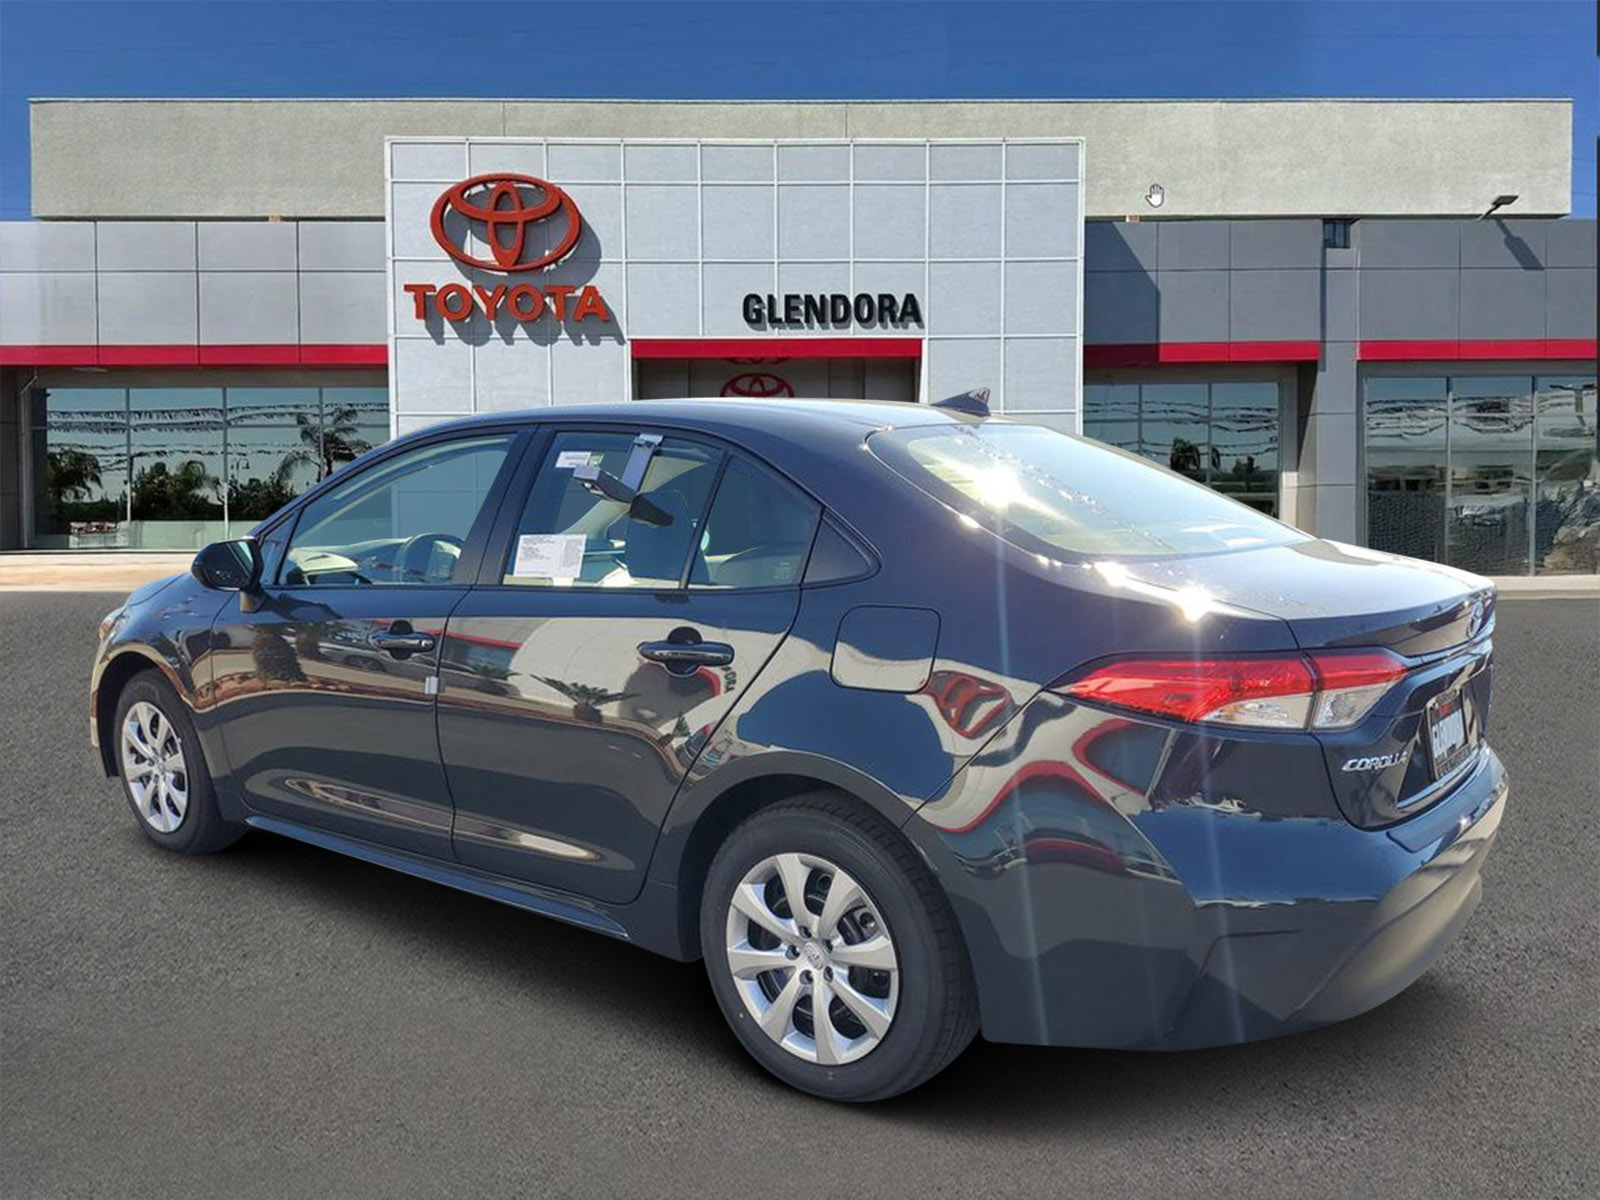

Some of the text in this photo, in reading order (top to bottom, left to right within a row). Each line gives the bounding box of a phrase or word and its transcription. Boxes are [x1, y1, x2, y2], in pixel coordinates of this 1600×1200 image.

[404, 283, 610, 323] TOYOTA
[743, 293, 922, 325] GLENDORA
[1342, 751, 1407, 770] COROLLA
